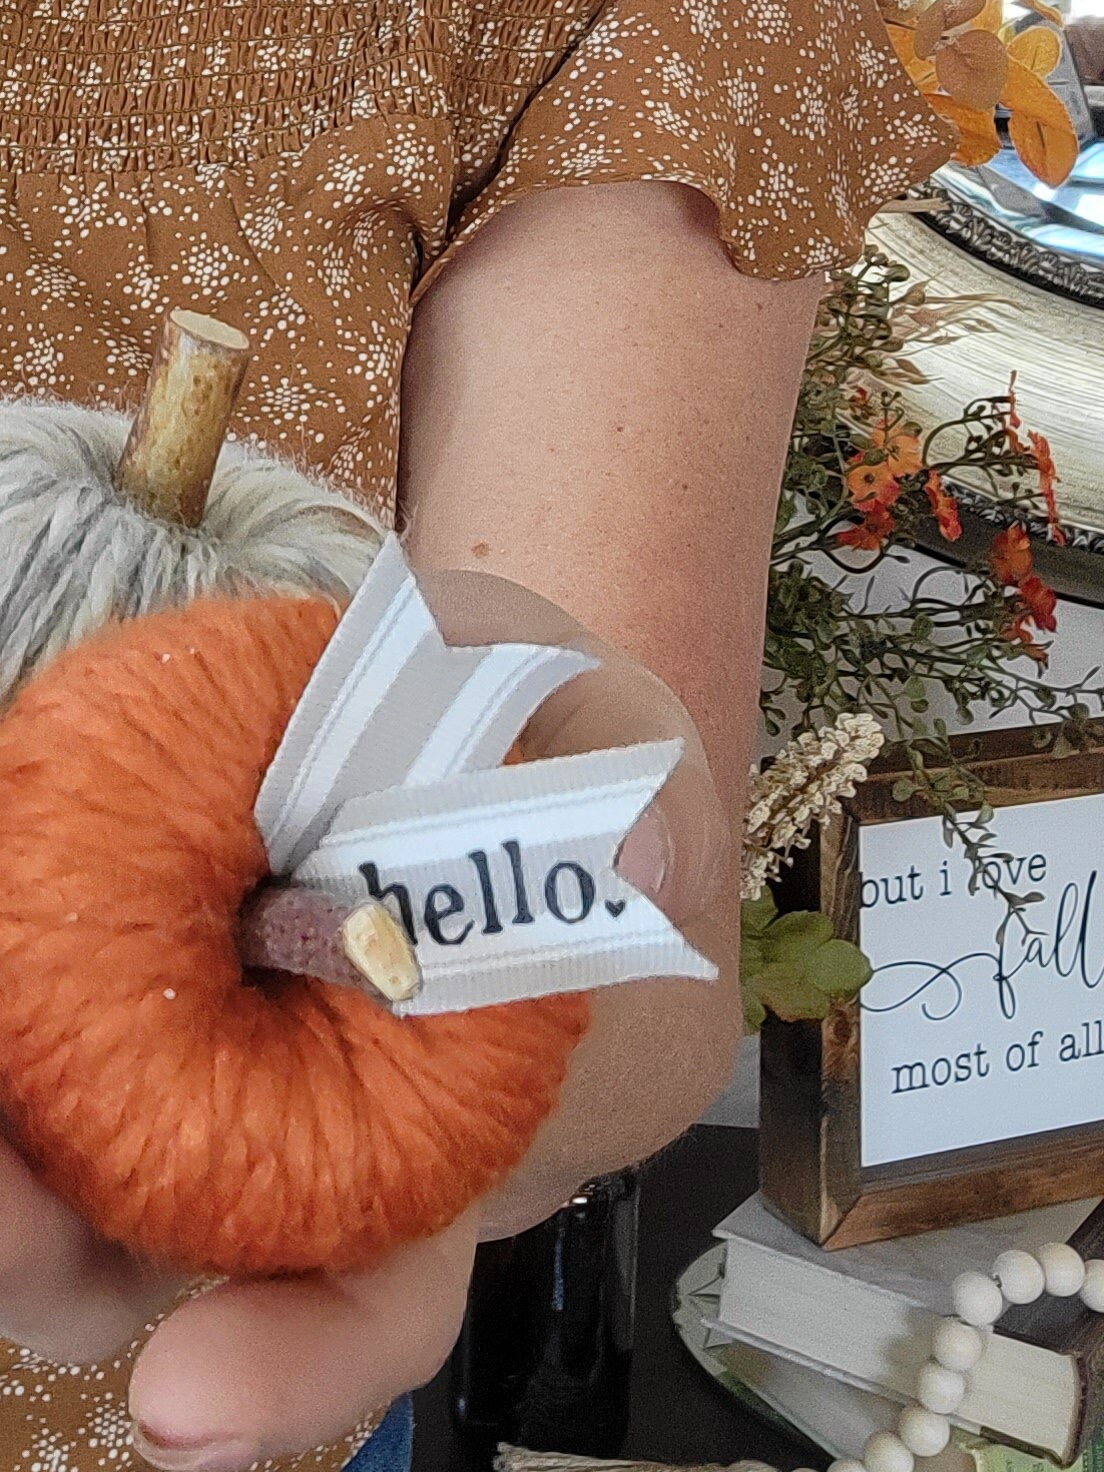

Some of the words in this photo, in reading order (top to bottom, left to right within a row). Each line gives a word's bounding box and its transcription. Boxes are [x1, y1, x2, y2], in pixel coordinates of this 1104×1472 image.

[858, 865, 924, 909] but
[939, 860, 952, 896] i
[968, 852, 1047, 892] ove
[891, 1042, 990, 1094] most
[1006, 1030, 1044, 1072] of
[1059, 1019, 1104, 1062] all
